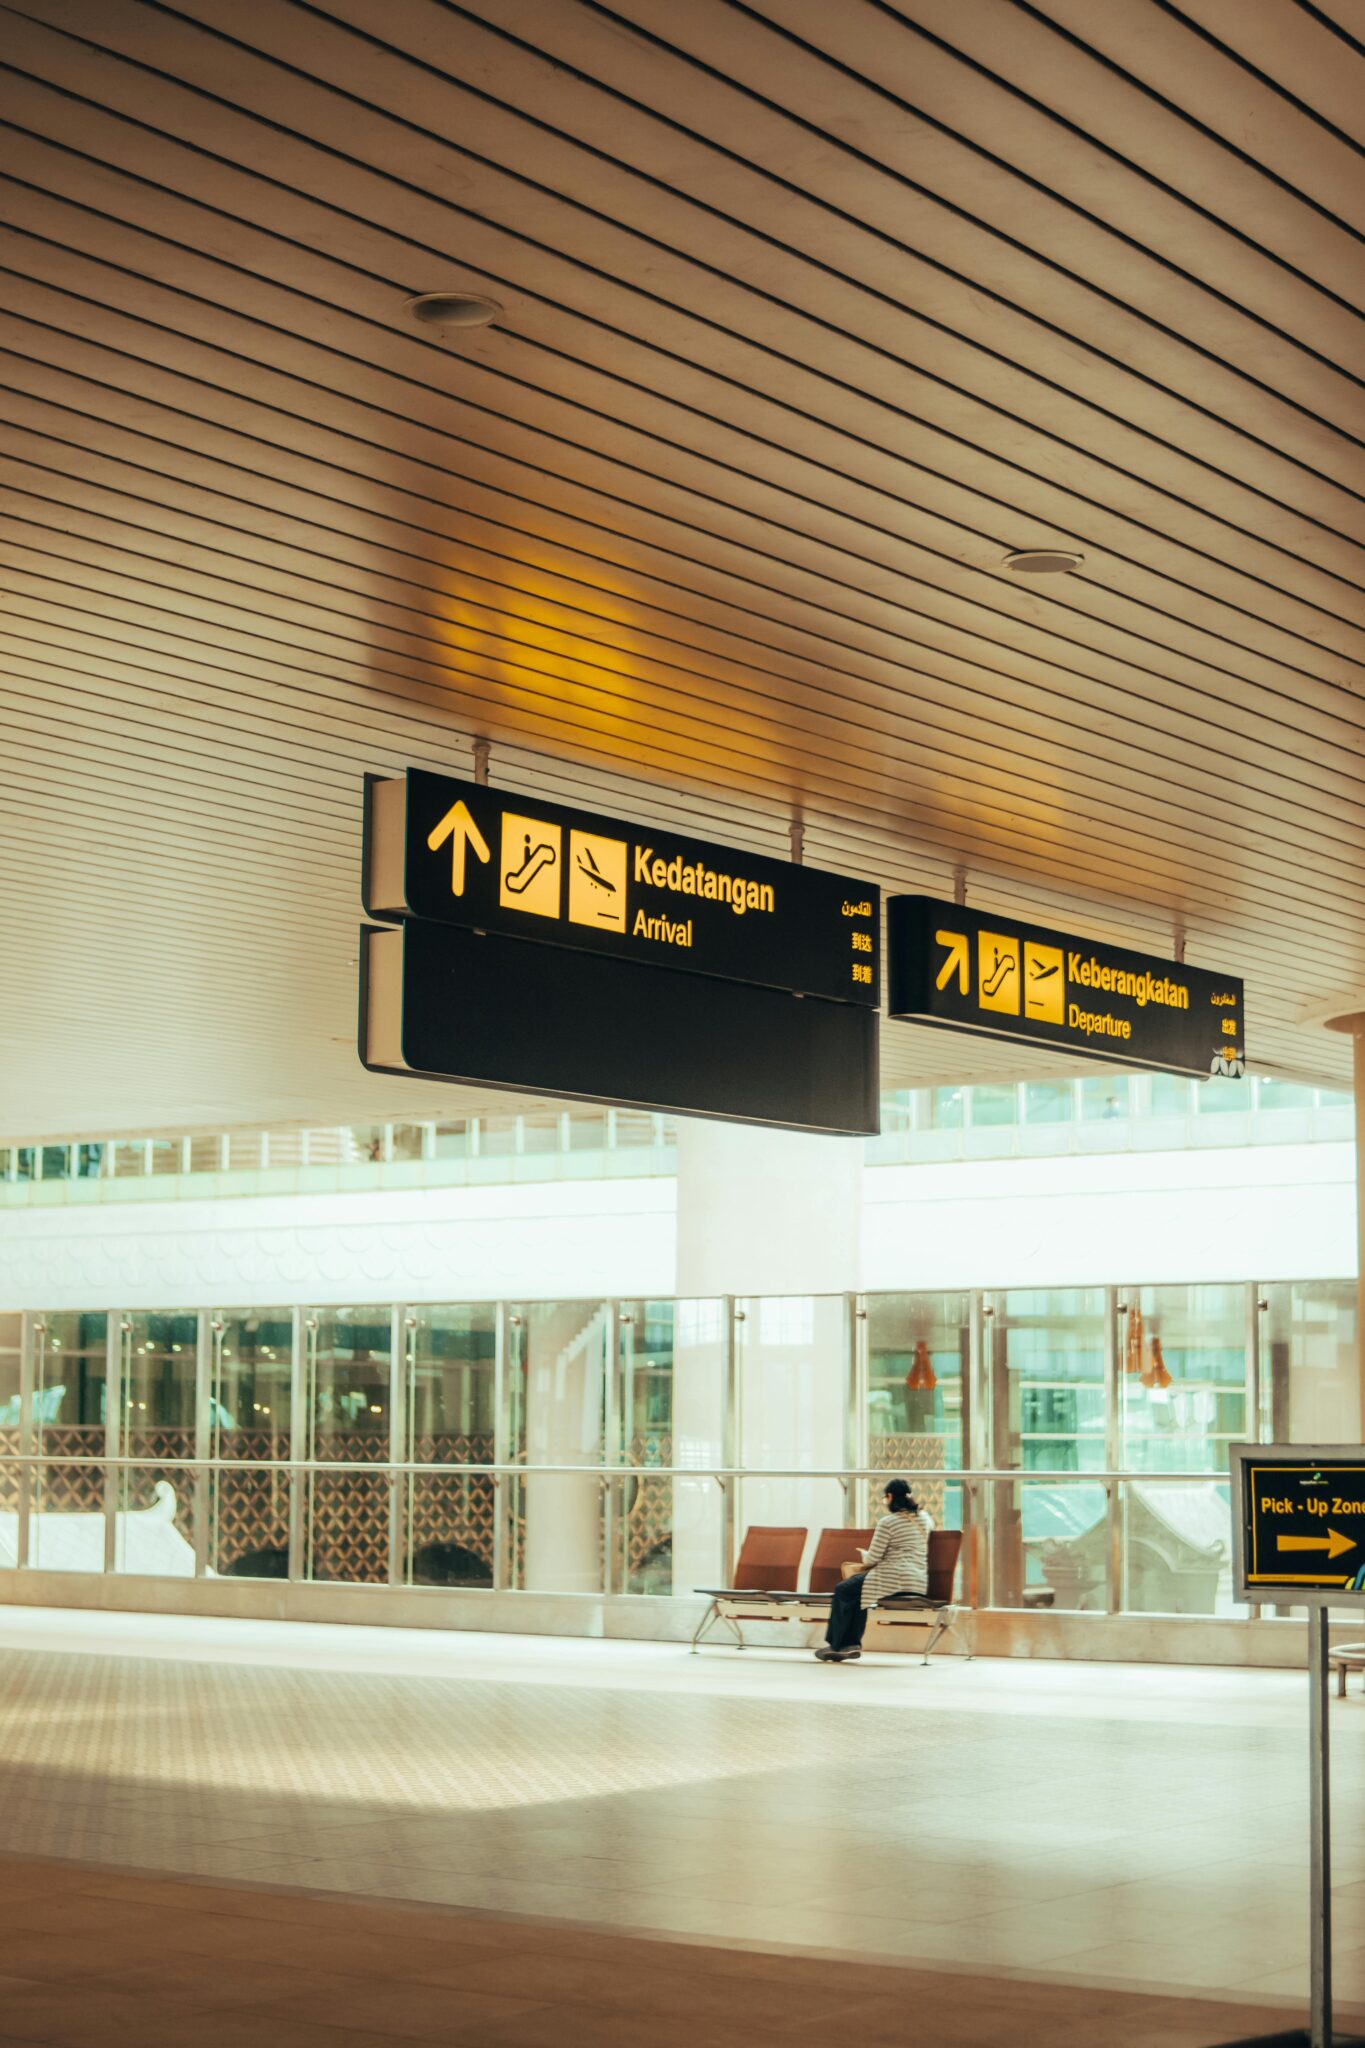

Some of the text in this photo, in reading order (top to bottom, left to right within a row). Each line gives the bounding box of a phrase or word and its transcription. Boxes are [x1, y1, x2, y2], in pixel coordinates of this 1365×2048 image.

[634, 845, 775, 915] Kedatangan
[632, 908, 693, 947] Arrival
[1068, 951, 1189, 1008] Keberangkatan
[1068, 1004, 1132, 1039] Departure
[1261, 1497, 1293, 1514] Pick
[1306, 1497, 1329, 1517] Up
